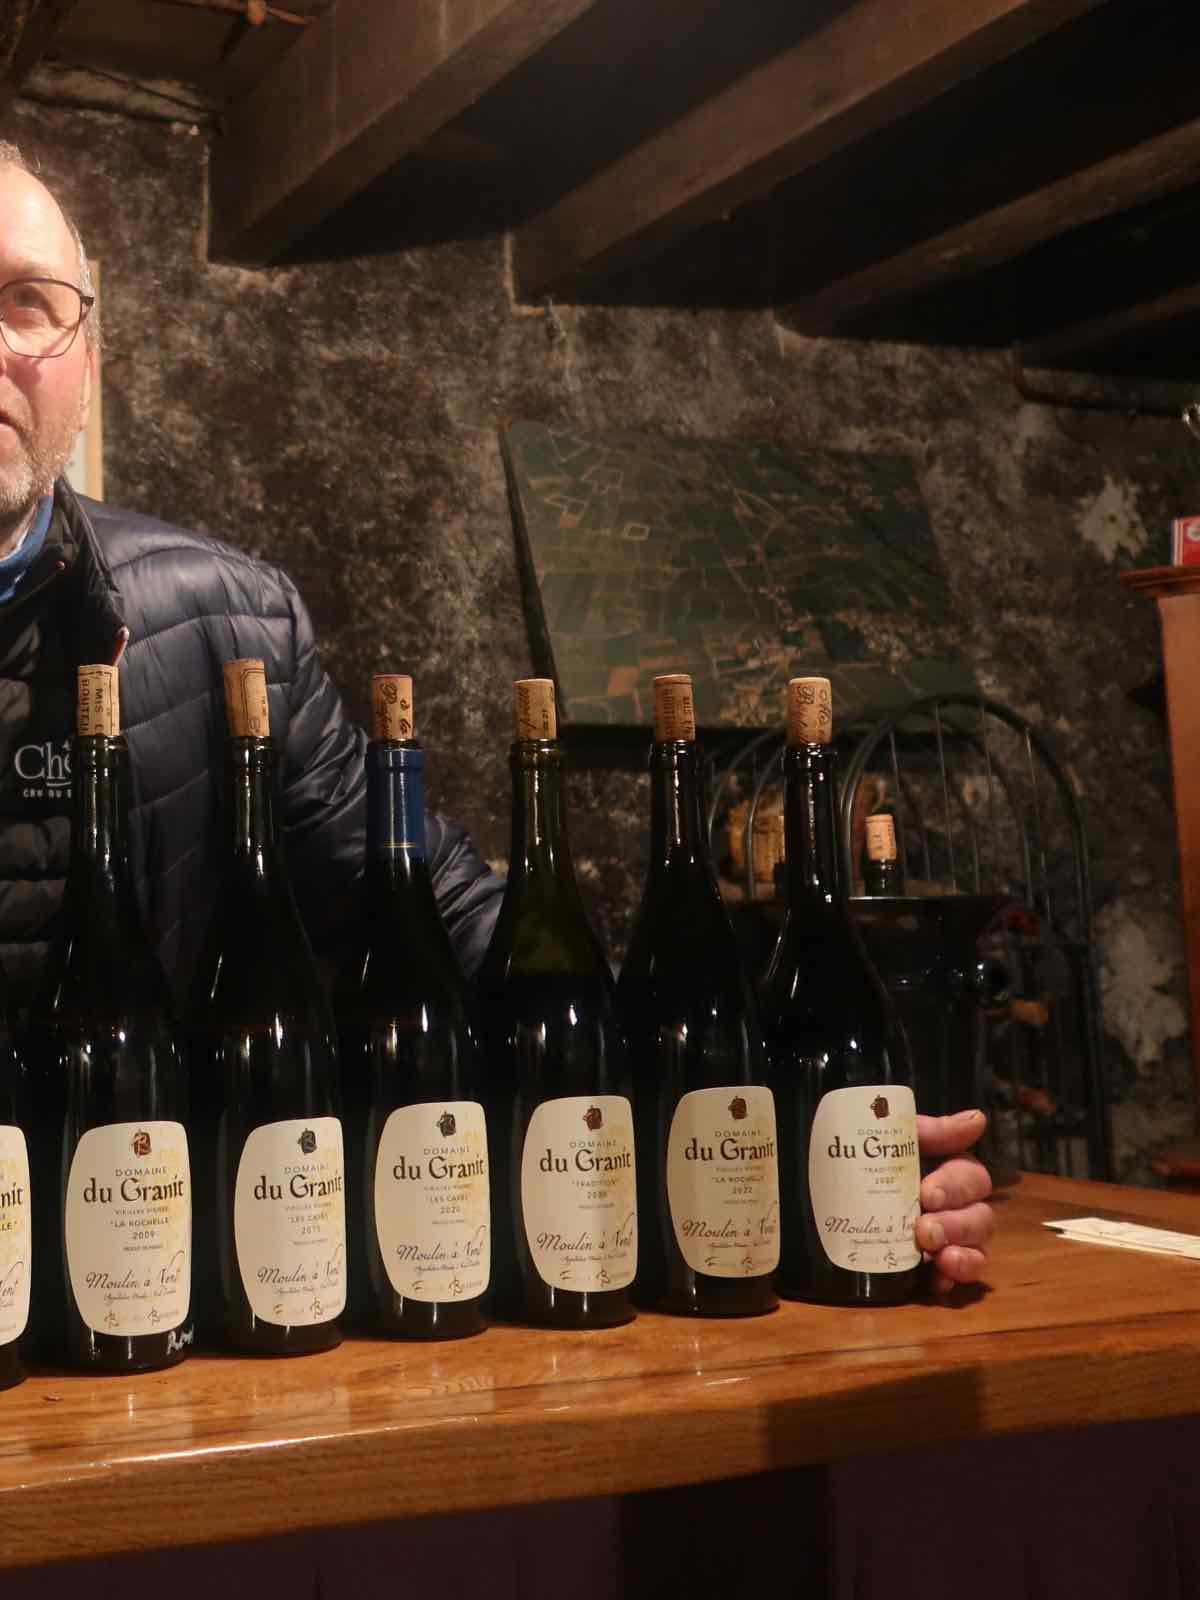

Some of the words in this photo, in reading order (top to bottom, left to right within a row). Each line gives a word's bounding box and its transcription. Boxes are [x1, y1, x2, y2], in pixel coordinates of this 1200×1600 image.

[715, 1129, 760, 1138] DOMAINE
[857, 1128, 903, 1136] DOMAINE
[424, 1145, 470, 1155] DOMAINE
[569, 1140, 616, 1149] DOMAINE
[685, 1138, 713, 1161] du
[720, 1136, 774, 1160] Granit
[828, 1136, 856, 1159] du
[863, 1136, 915, 1158] Granit
[284, 1163, 328, 1175] DOMAINE
[393, 1155, 421, 1180] du
[428, 1154, 484, 1179] Granit
[540, 1148, 568, 1172] du
[575, 1146, 631, 1171] Granit
[115, 1166, 167, 1177] DOMAINE
[83, 1177, 112, 1203] du
[120, 1175, 184, 1202] Granit
[254, 1176, 283, 1200] du
[289, 1170, 342, 1198] Granit
[682, 1218, 737, 1238] Moulin
[825, 1215, 880, 1234] Moulin
[133, 1231, 155, 1240] 2009
[537, 1231, 592, 1251] Moulin
[396, 1241, 446, 1260] Moulin
[85, 1269, 137, 1289] Moulin
[257, 1263, 306, 1284] Moulin
